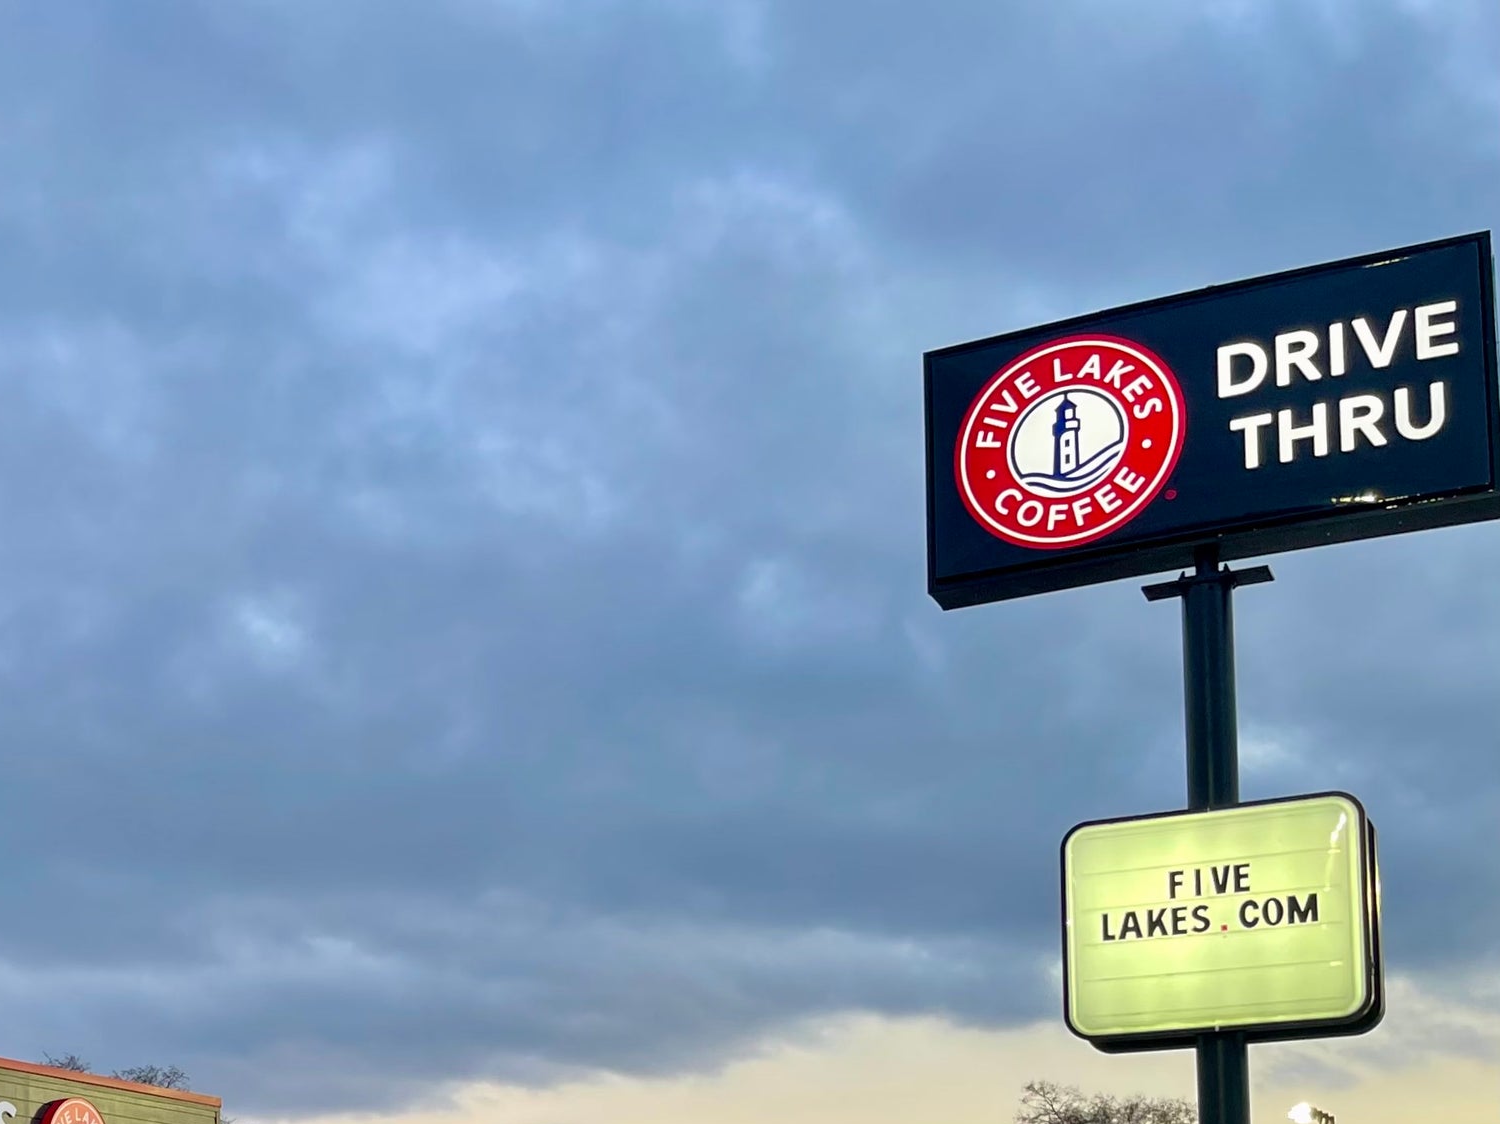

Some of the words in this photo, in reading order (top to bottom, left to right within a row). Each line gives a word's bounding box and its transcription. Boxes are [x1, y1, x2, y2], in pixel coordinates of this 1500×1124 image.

[1217, 300, 1459, 398] DRIVE
[975, 371, 1041, 448] FIVE
[1053, 354, 1163, 419] LAKES
[1229, 381, 1446, 470] THRU
[994, 466, 1146, 531] COFFEE
[1168, 863, 1251, 899] FIVE
